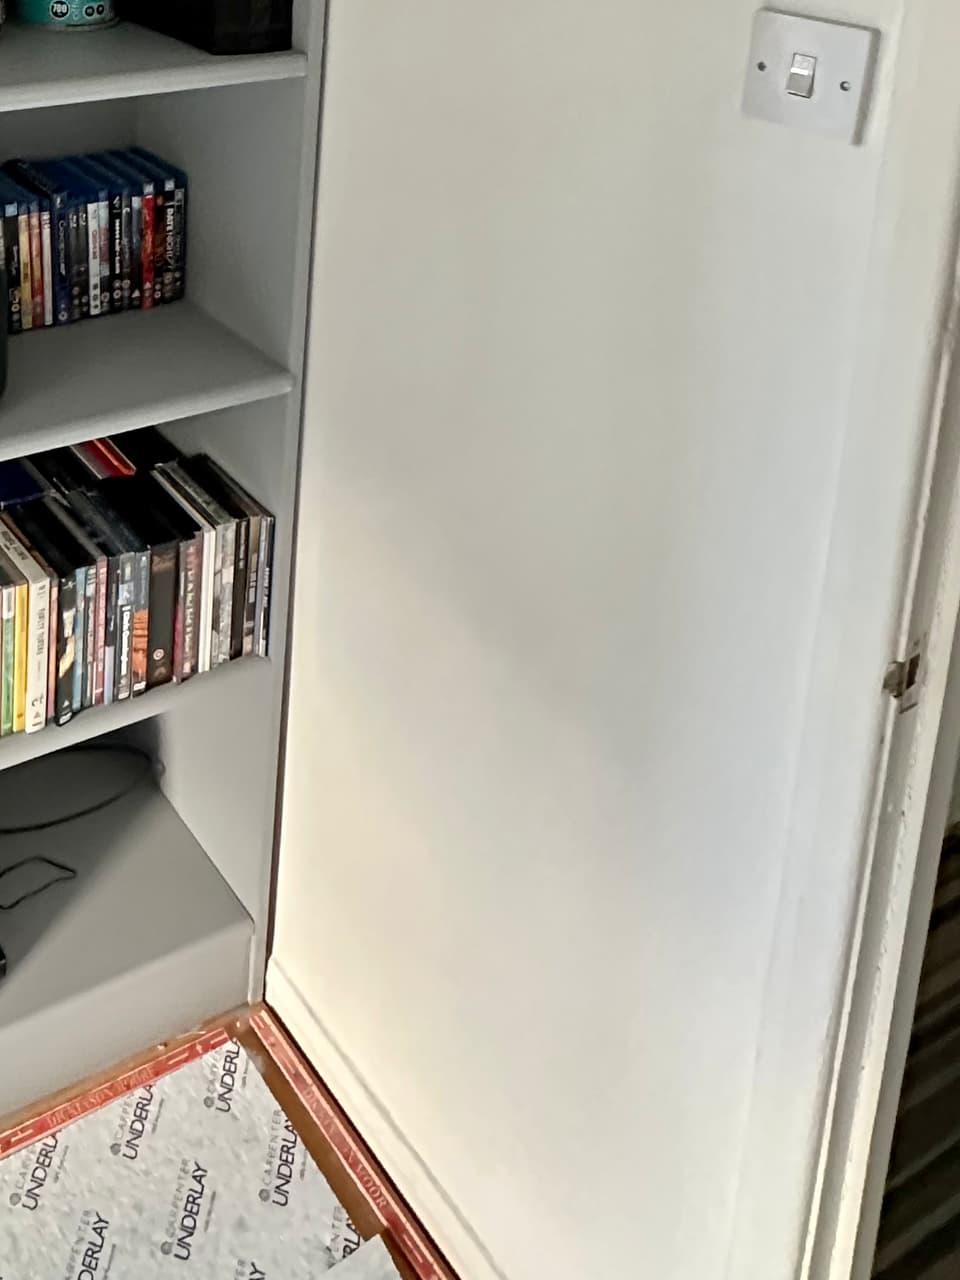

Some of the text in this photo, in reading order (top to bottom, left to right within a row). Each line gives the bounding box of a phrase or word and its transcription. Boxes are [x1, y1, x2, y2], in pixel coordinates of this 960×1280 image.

[216, 1038, 241, 1113] UNDERLA
[122, 1080, 156, 1160] UNDERLA
[262, 1109, 281, 1186] CARPENTER
[22, 1130, 62, 1211] UNDERLA
[272, 1119, 298, 1207] UNDERLA
[77, 1211, 110, 1280] DERLAY
[174, 1160, 208, 1262] UNDERLAY
